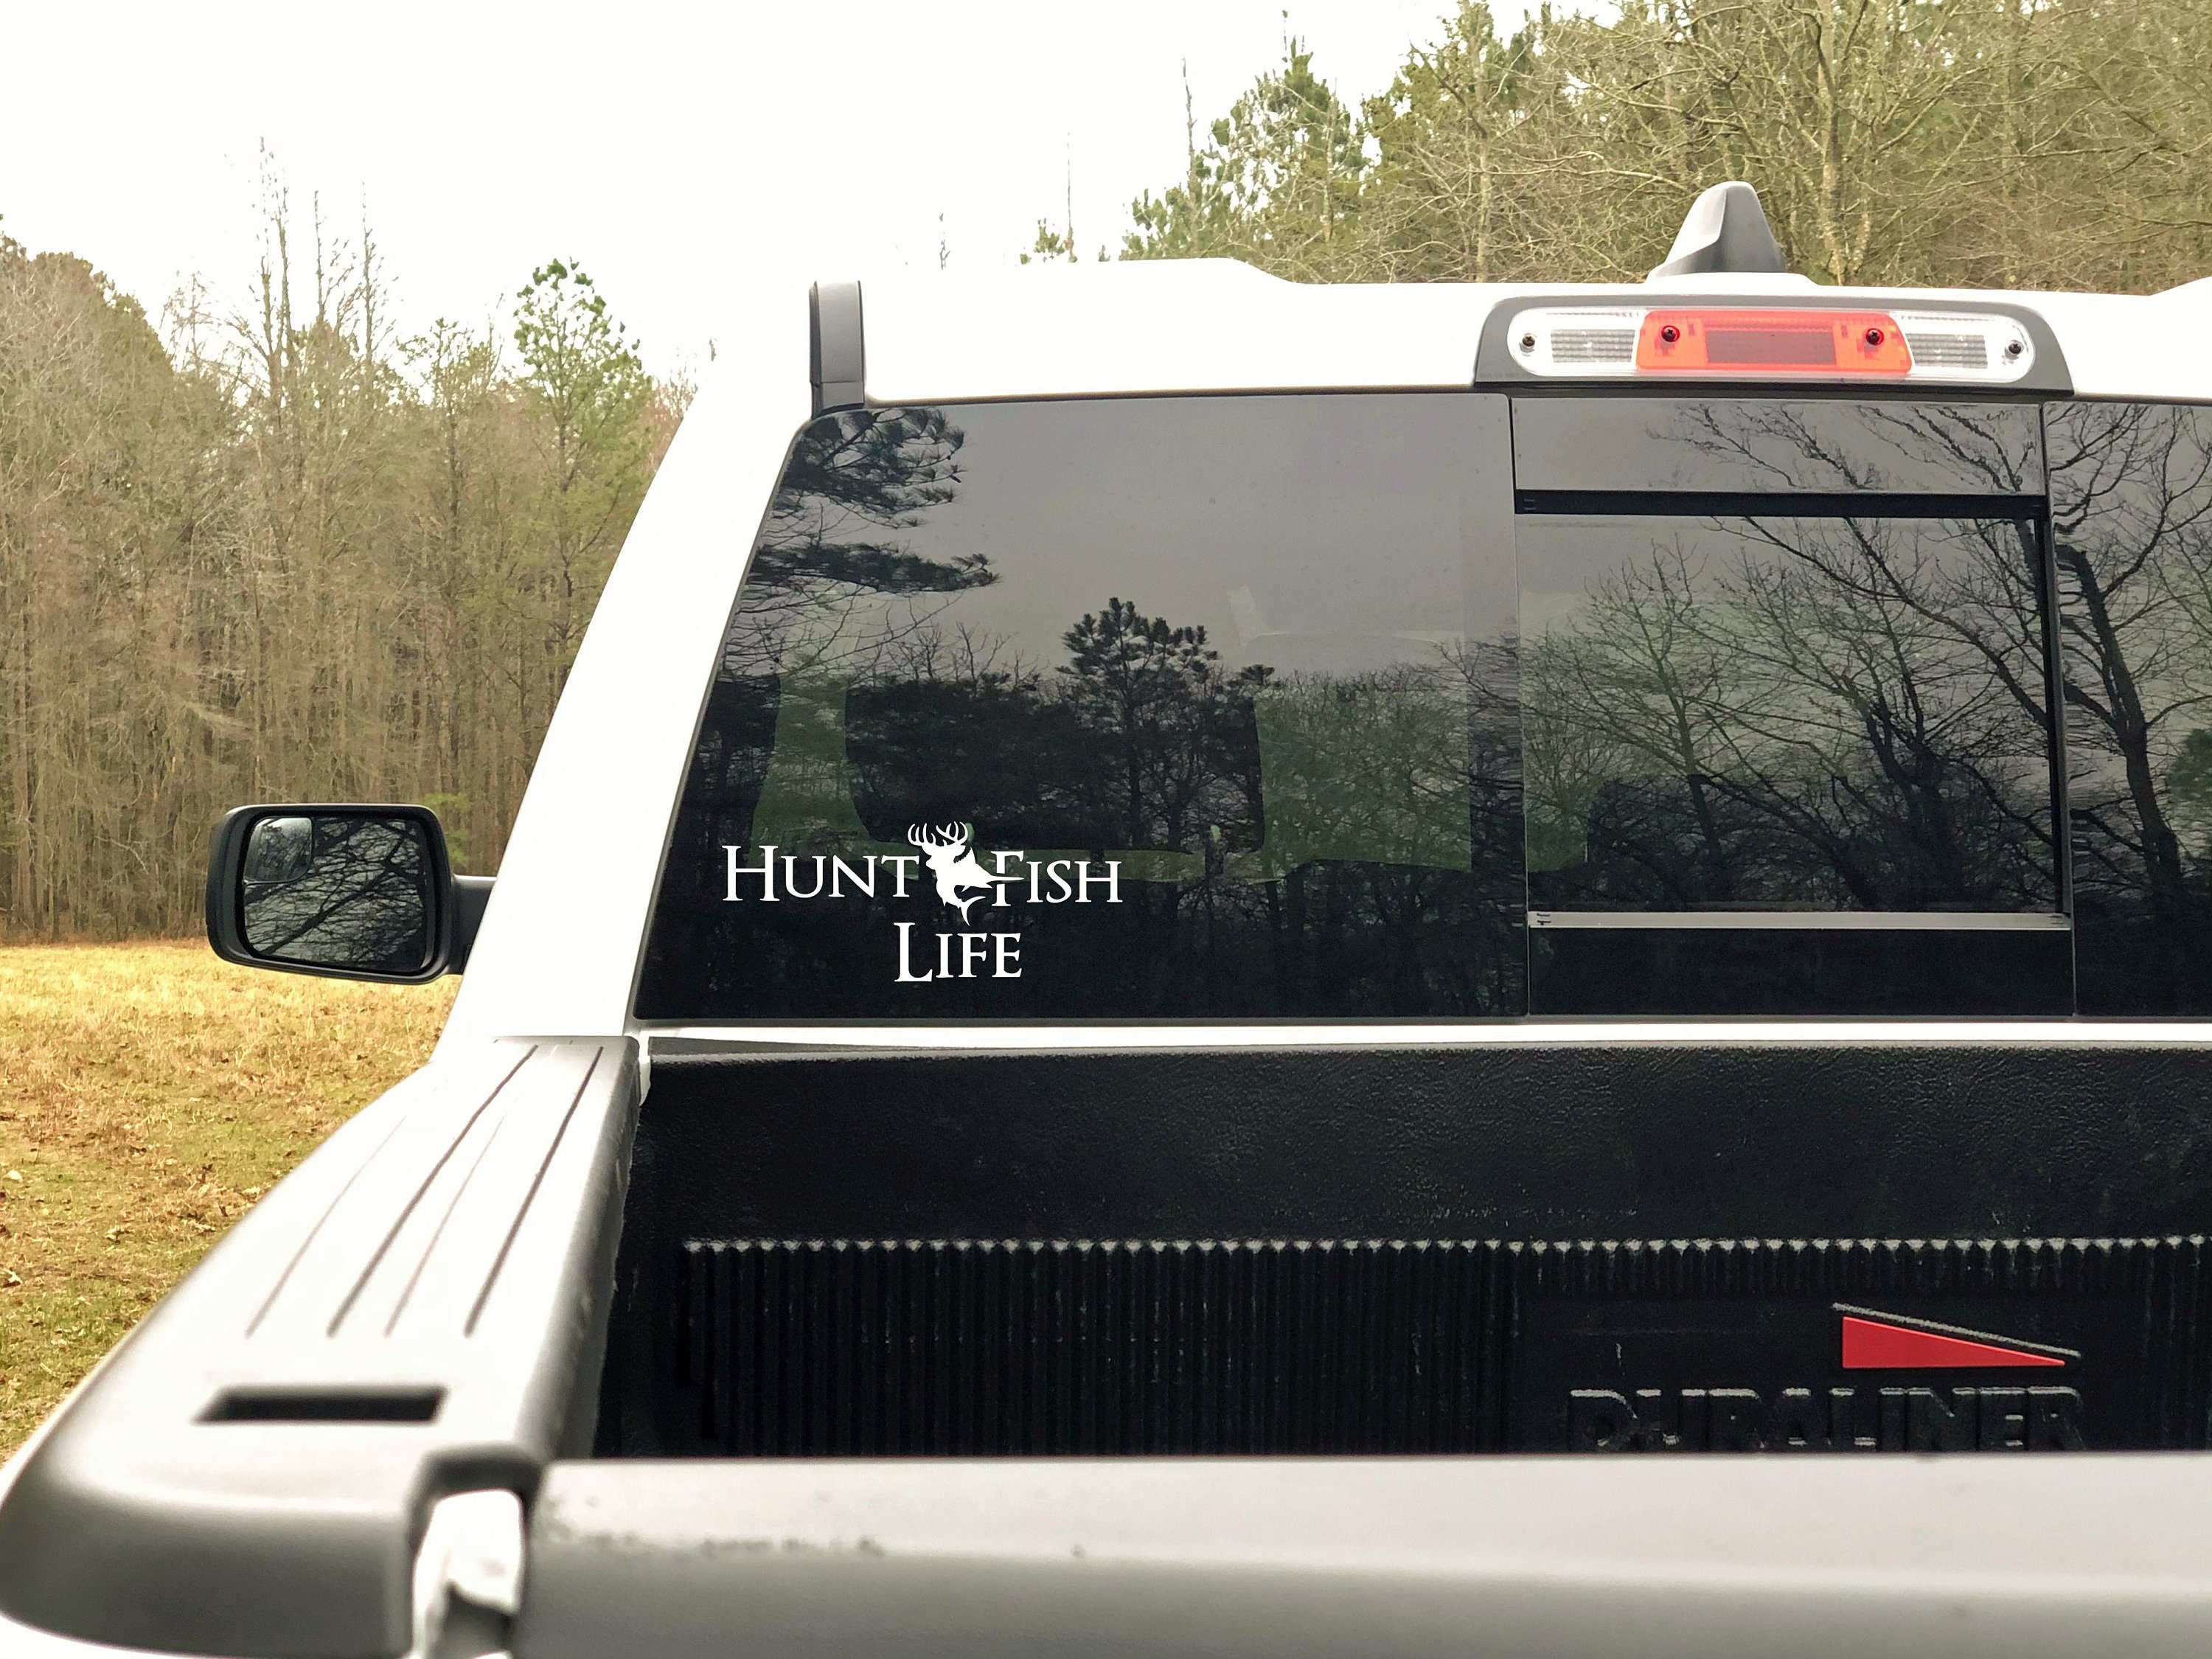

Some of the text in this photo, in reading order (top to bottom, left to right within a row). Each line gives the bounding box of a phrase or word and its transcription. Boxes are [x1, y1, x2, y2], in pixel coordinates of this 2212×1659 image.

[722, 846, 1123, 907] HUNT FISH
[894, 922, 1022, 982] LIFE
